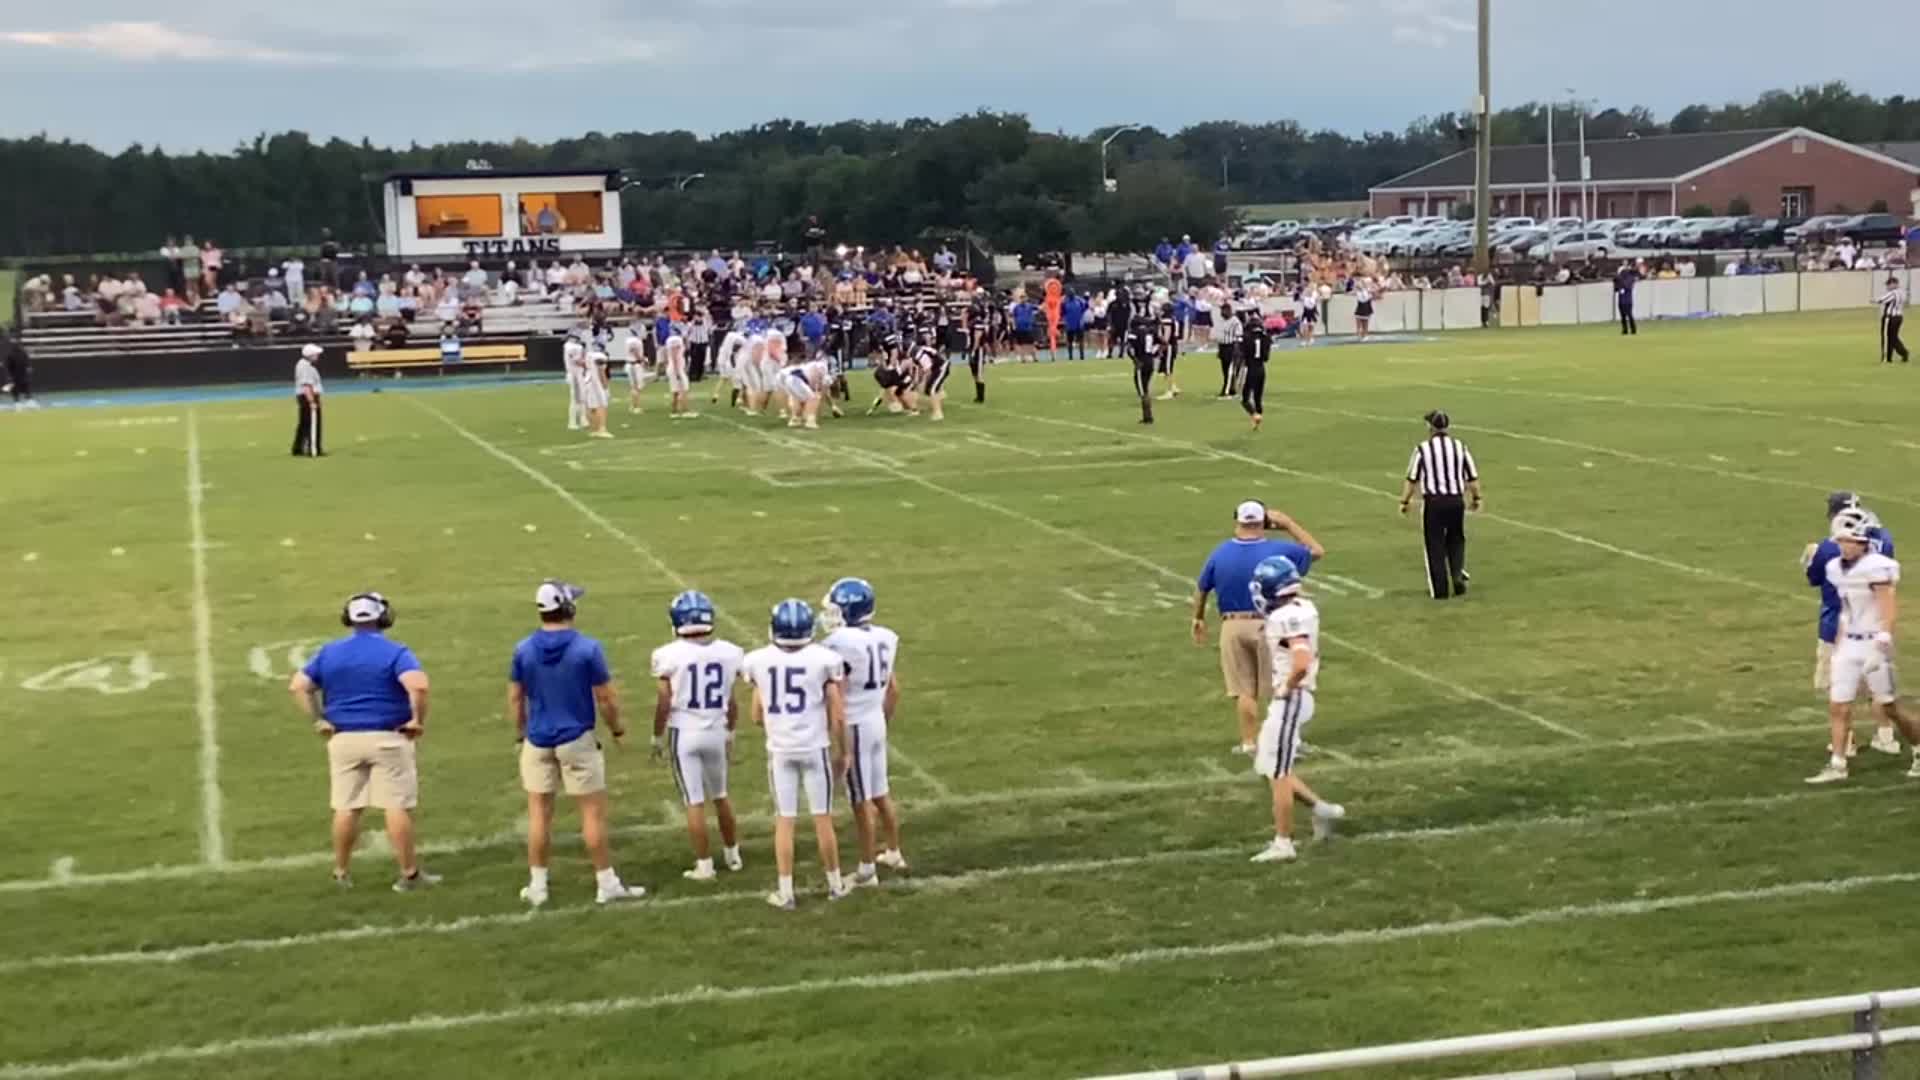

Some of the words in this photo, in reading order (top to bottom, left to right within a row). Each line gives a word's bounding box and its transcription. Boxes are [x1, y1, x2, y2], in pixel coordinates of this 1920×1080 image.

[462, 239, 560, 256] TITANS
[687, 662, 723, 709] 12
[767, 666, 806, 714] 15
